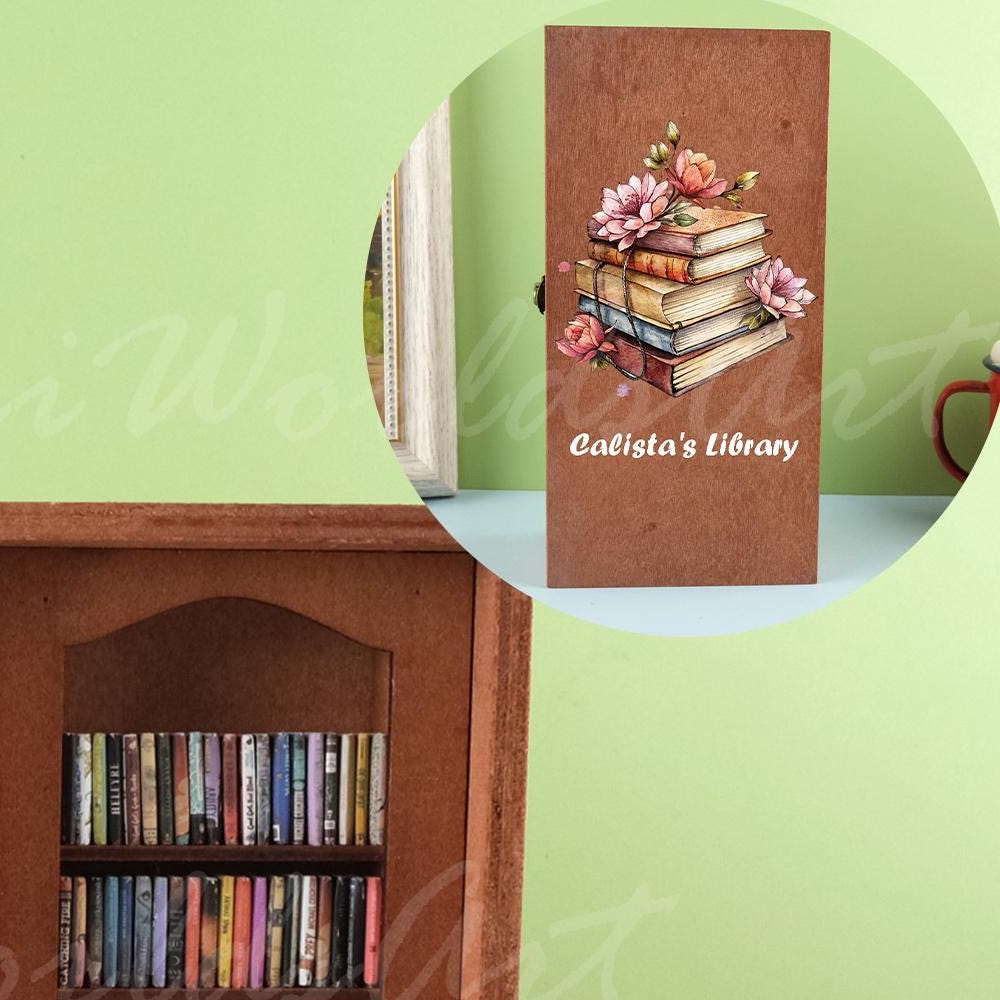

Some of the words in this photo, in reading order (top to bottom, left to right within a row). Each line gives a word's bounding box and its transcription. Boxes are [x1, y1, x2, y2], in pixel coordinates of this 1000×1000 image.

[569, 431, 697, 459] Calista's
[705, 431, 799, 462] Library
[61, 901, 71, 925] FIRE
[60, 926, 70, 985] CATCHING
